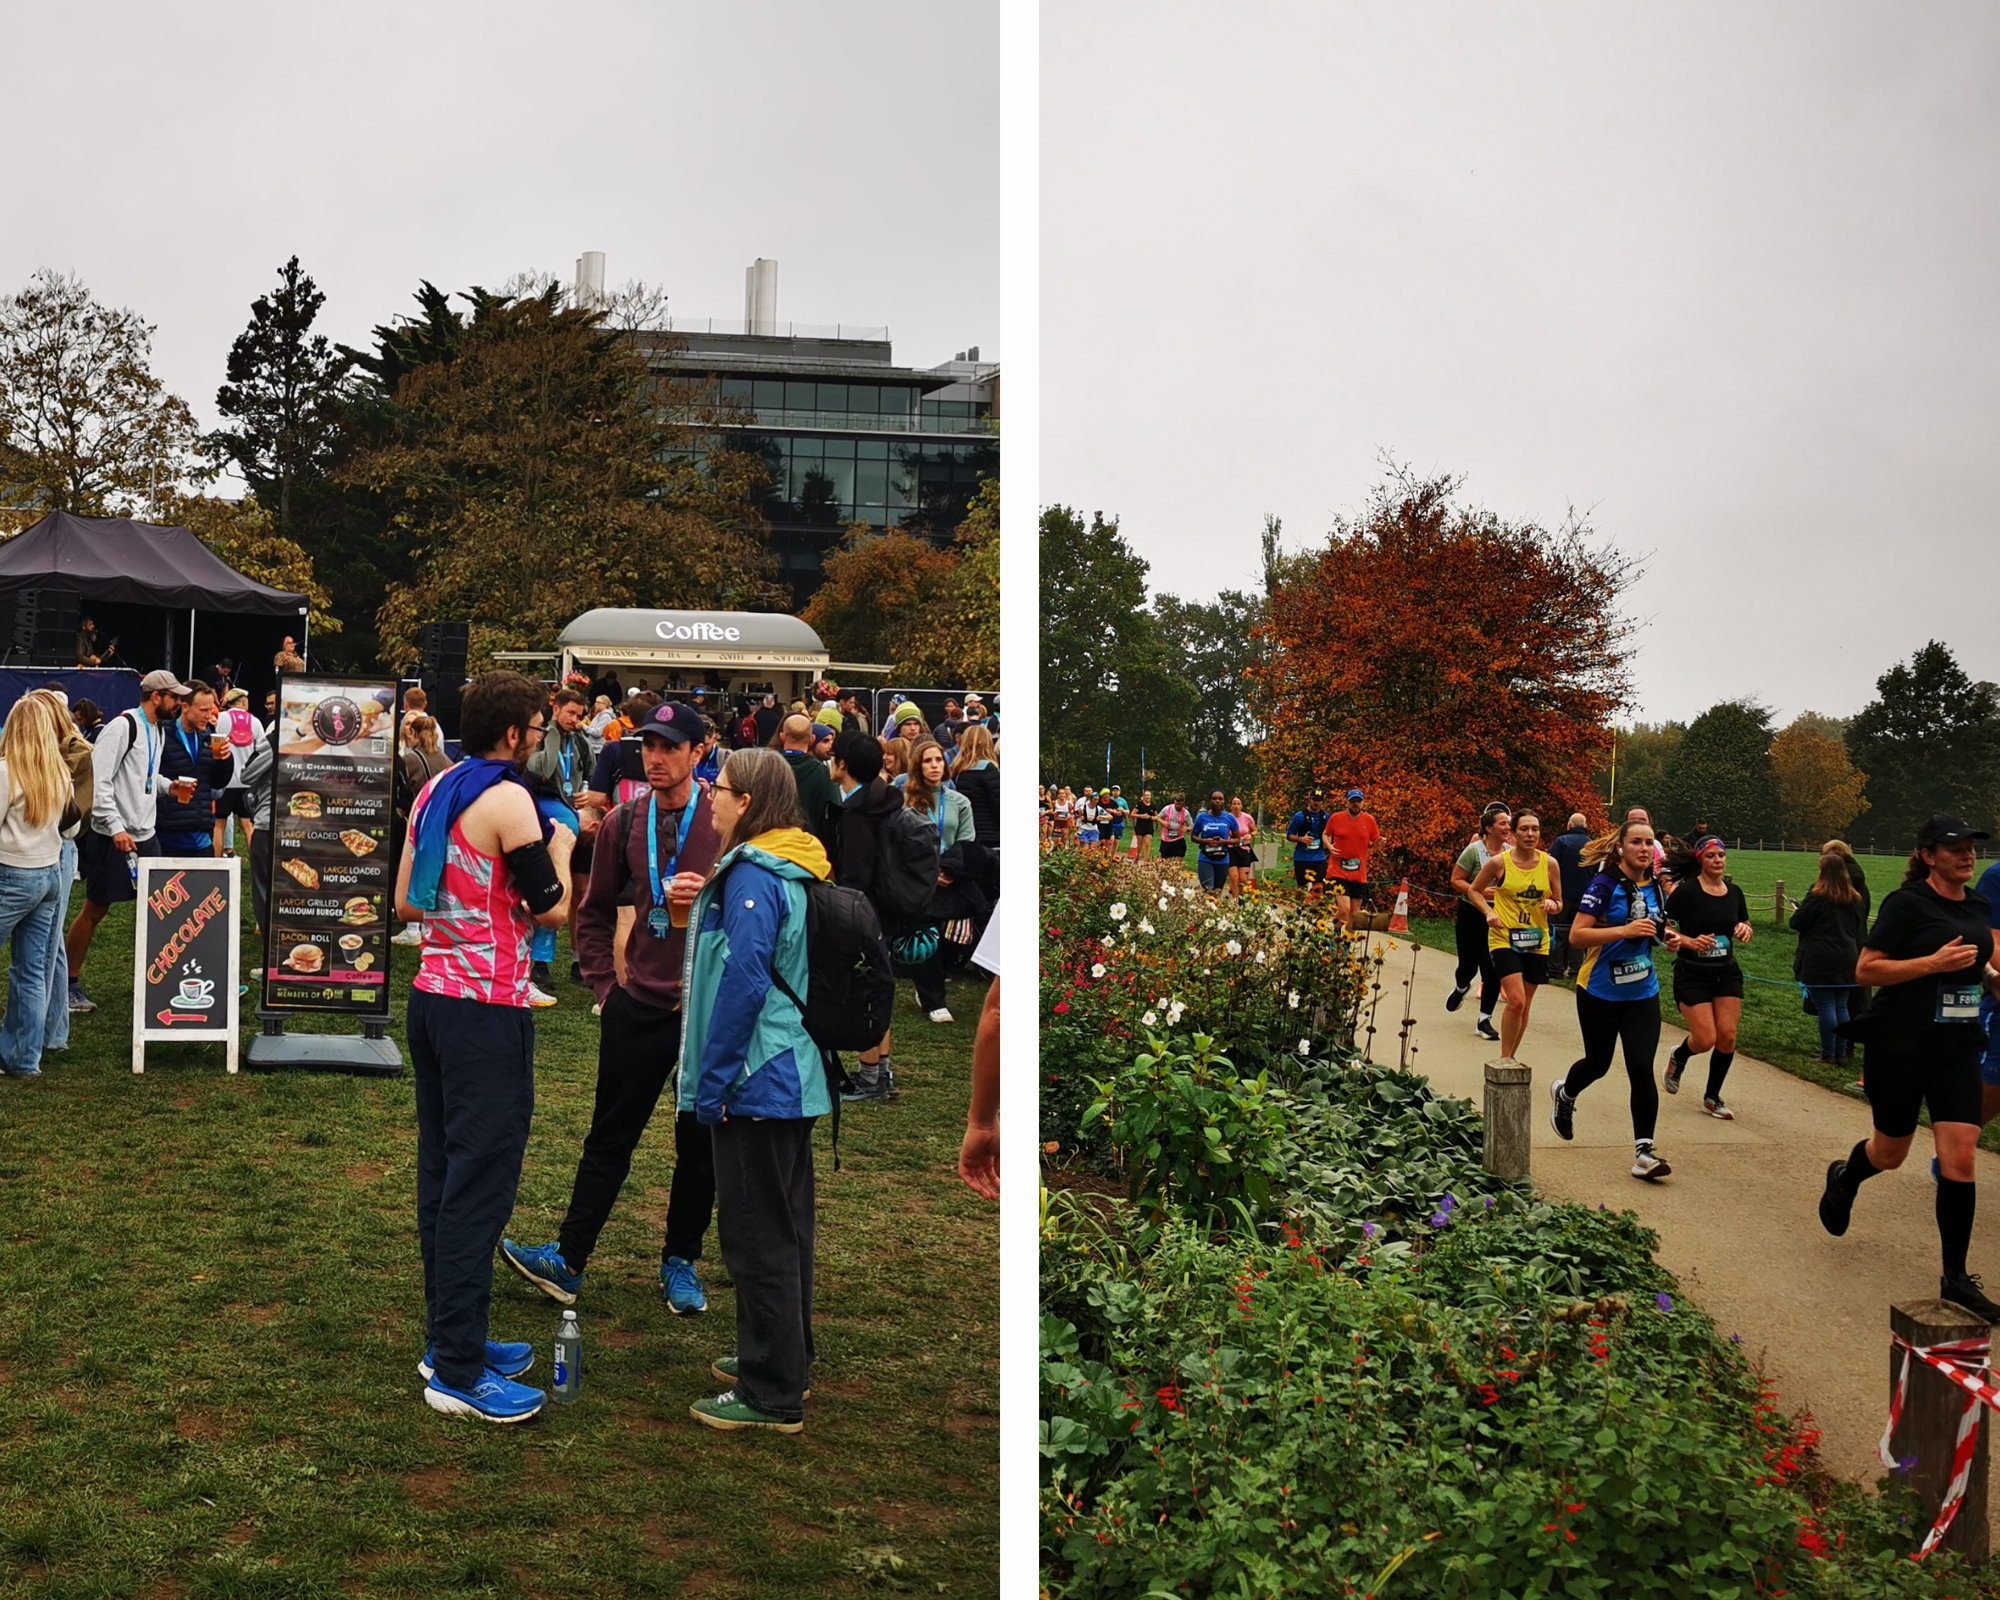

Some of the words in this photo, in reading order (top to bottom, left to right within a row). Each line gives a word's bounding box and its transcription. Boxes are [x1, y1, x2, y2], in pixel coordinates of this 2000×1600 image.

[655, 621, 741, 641] Coffee
[587, 649, 611, 657] BAKED
[612, 650, 639, 658] GOODS
[719, 653, 745, 661] COFFEE
[319, 697, 351, 710] CHARMING
[350, 703, 361, 723] BELLE
[285, 762, 304, 770] THE
[306, 763, 354, 773] CHARMING
[357, 766, 386, 774] BELLE
[290, 771, 320, 782] Mobile
[326, 797, 354, 807] LARGE
[354, 799, 384, 808] ANGUS
[326, 807, 344, 815] BEEF
[345, 807, 376, 817] BURGER
[281, 830, 306, 839] LARGE
[307, 831, 339, 840] LOADED
[281, 839, 301, 848] FRIES
[323, 866, 349, 875] LARGE
[349, 866, 381, 876] LOADED
[323, 875, 339, 883] HOT
[340, 875, 358, 884] DOG
[148, 871, 191, 920] HOT
[280, 898, 306, 907] LARGE
[307, 898, 340, 908] GRILLED
[279, 906, 315, 916] HALLOUMI
[316, 908, 344, 917] BURGER
[1519, 911, 1531, 925] LIZ
[147, 886, 227, 985] CHOCOLATE
[281, 933, 310, 942] BACON
[311, 934, 331, 943] ROLL
[345, 972, 374, 981] Coffee
[276, 990, 309, 999] MEMBERS
[553, 1342, 561, 1381] smart
